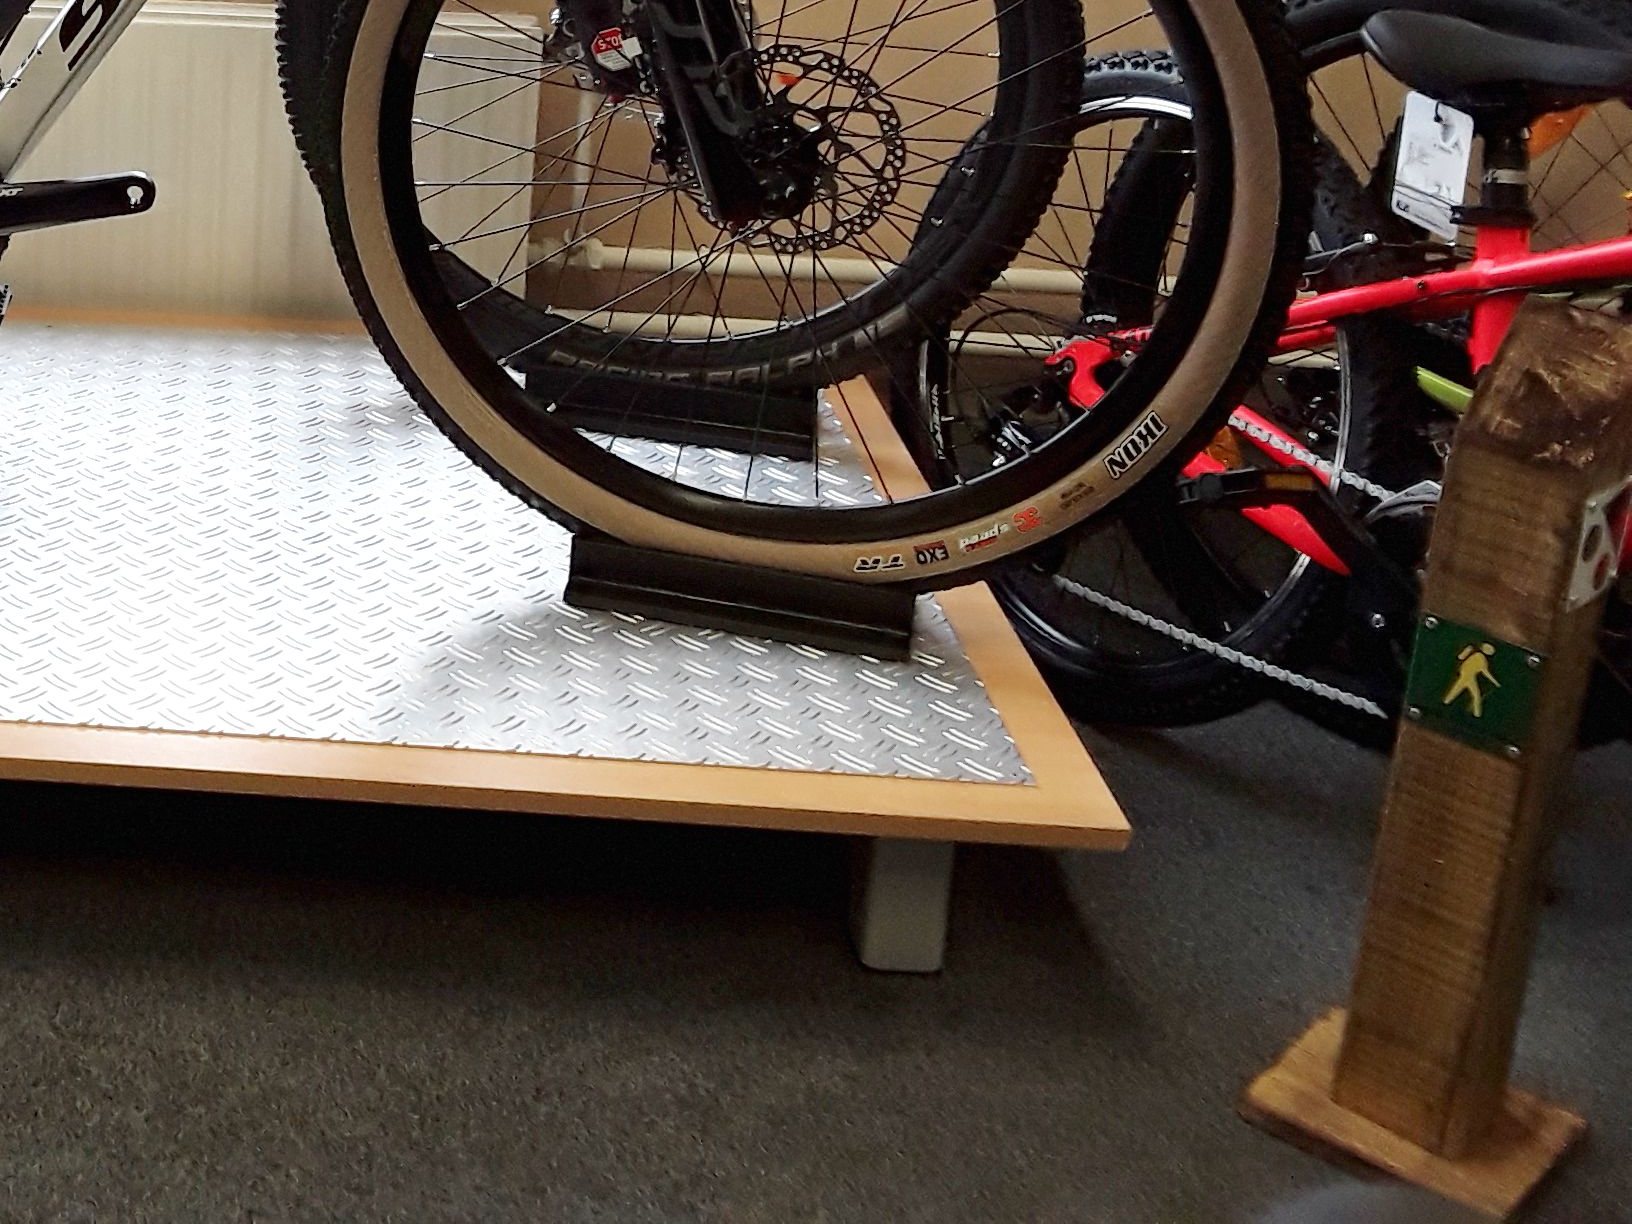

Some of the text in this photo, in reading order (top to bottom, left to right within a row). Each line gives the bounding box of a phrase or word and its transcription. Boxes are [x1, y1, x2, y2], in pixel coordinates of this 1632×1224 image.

[1102, 410, 1168, 480] IKON
[853, 552, 907, 574] TR
[916, 544, 951, 566] EXO
